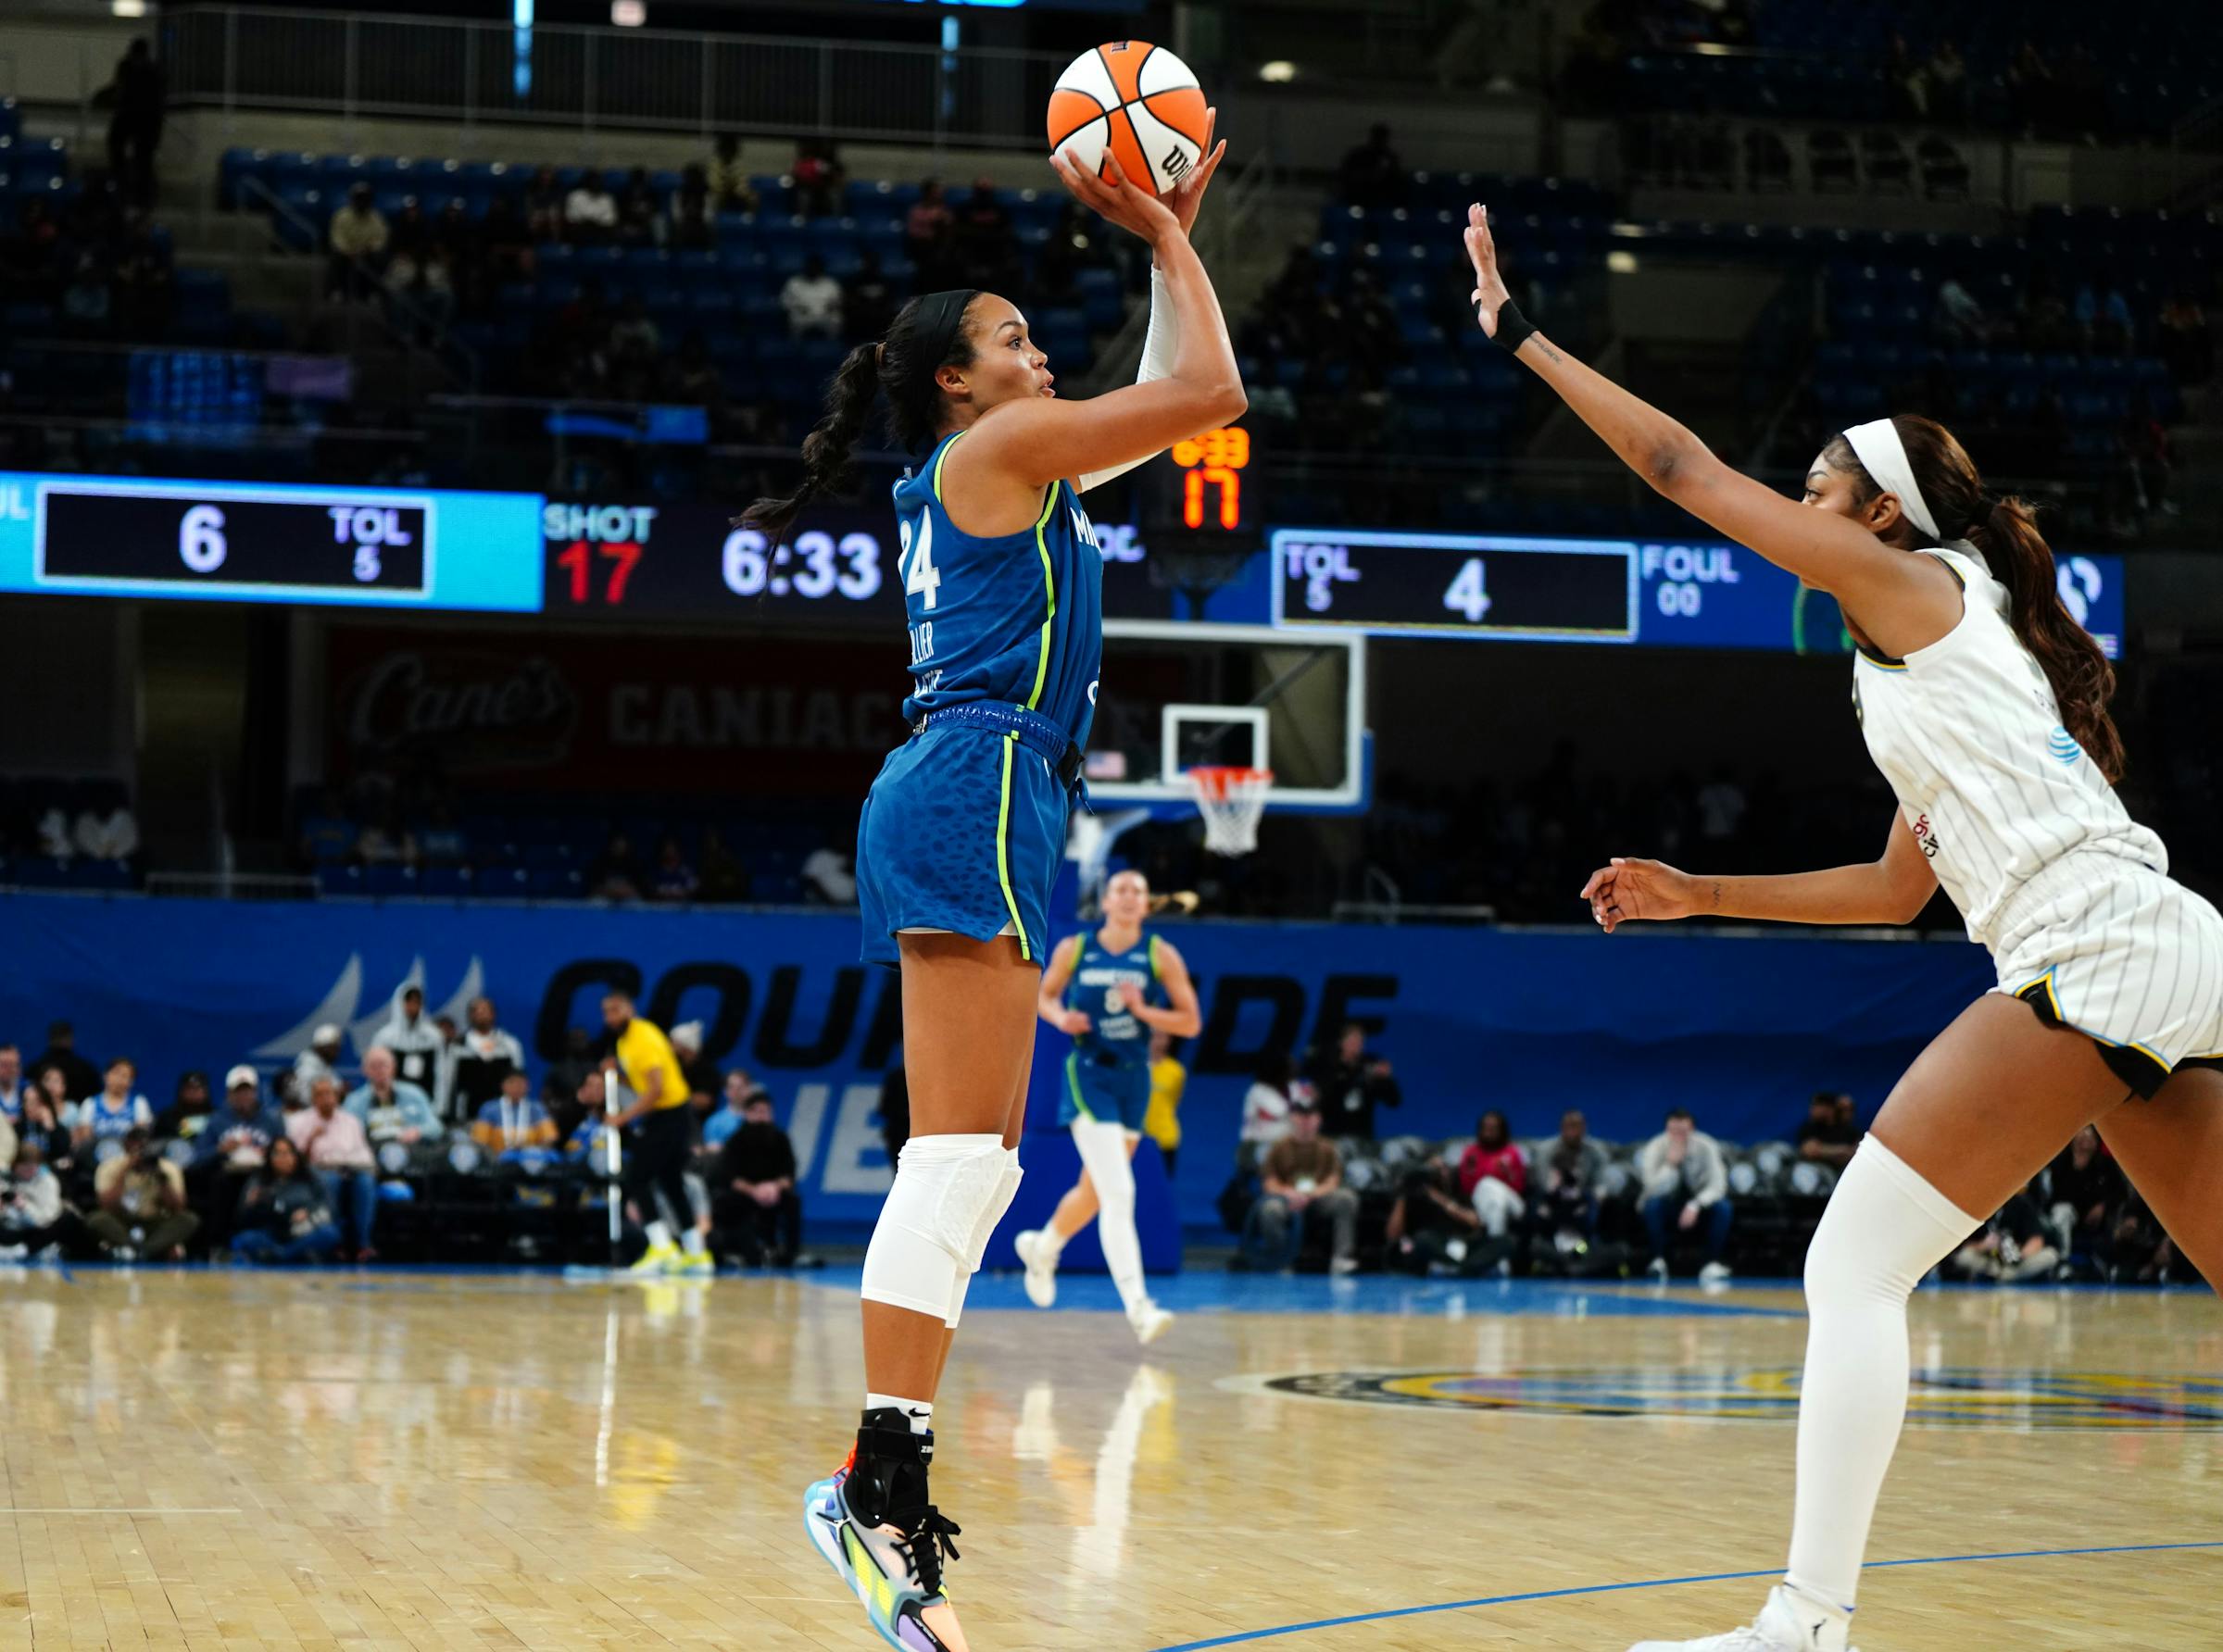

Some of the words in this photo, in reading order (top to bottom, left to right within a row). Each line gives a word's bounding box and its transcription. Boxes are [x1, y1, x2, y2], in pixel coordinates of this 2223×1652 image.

[544, 504, 657, 544] SHOT
[1184, 469, 1239, 530] 17
[179, 505, 227, 572] 6
[328, 506, 410, 545] TOL
[353, 545, 381, 582] 5
[559, 541, 643, 603] 17
[721, 529, 883, 600] 6:33
[1286, 544, 1361, 582] TOL
[1642, 544, 1739, 582] FOUL
[1442, 557, 1492, 622] 4
